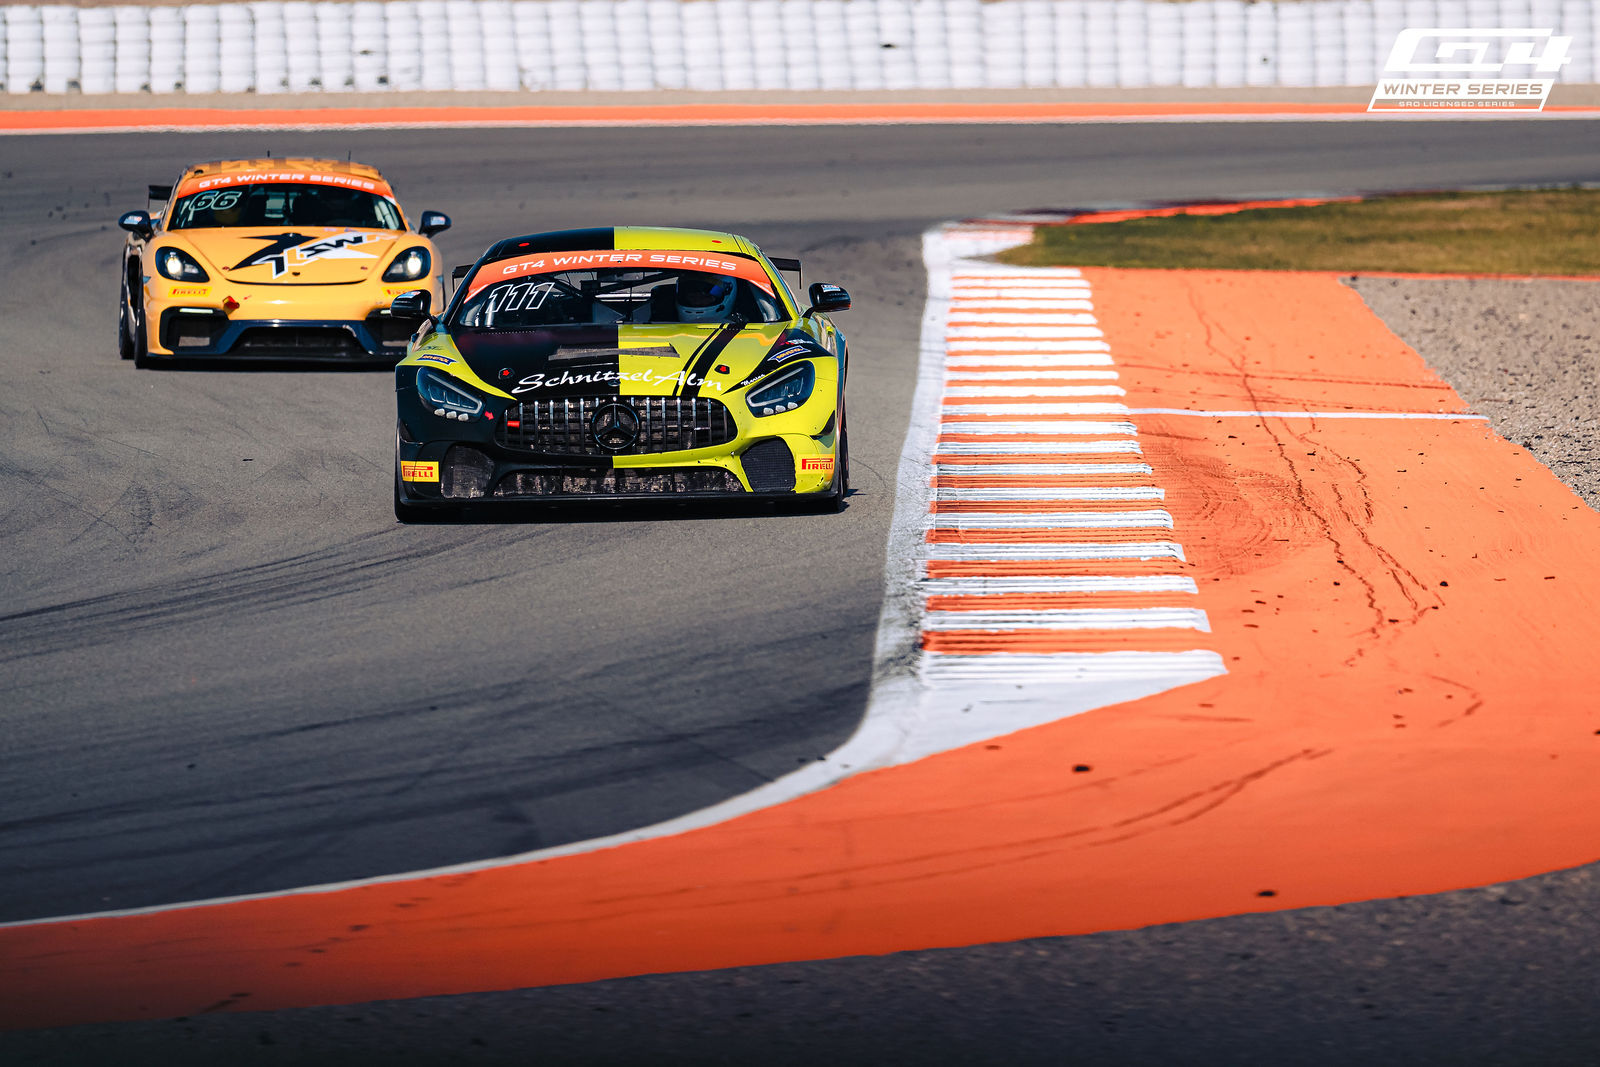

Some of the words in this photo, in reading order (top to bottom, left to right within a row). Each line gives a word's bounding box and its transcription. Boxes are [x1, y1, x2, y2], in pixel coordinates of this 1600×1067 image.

[199, 176, 231, 188] GT4
[236, 173, 304, 183] WINTER
[310, 174, 375, 189] SERIES
[189, 190, 242, 211] 66
[502, 260, 545, 275] GT4
[553, 253, 643, 265] WINTER
[649, 254, 737, 271] SERIES
[484, 281, 555, 314] 111
[402, 466, 434, 477] PIRELLI
[802, 458, 833, 470] PIRELLI
